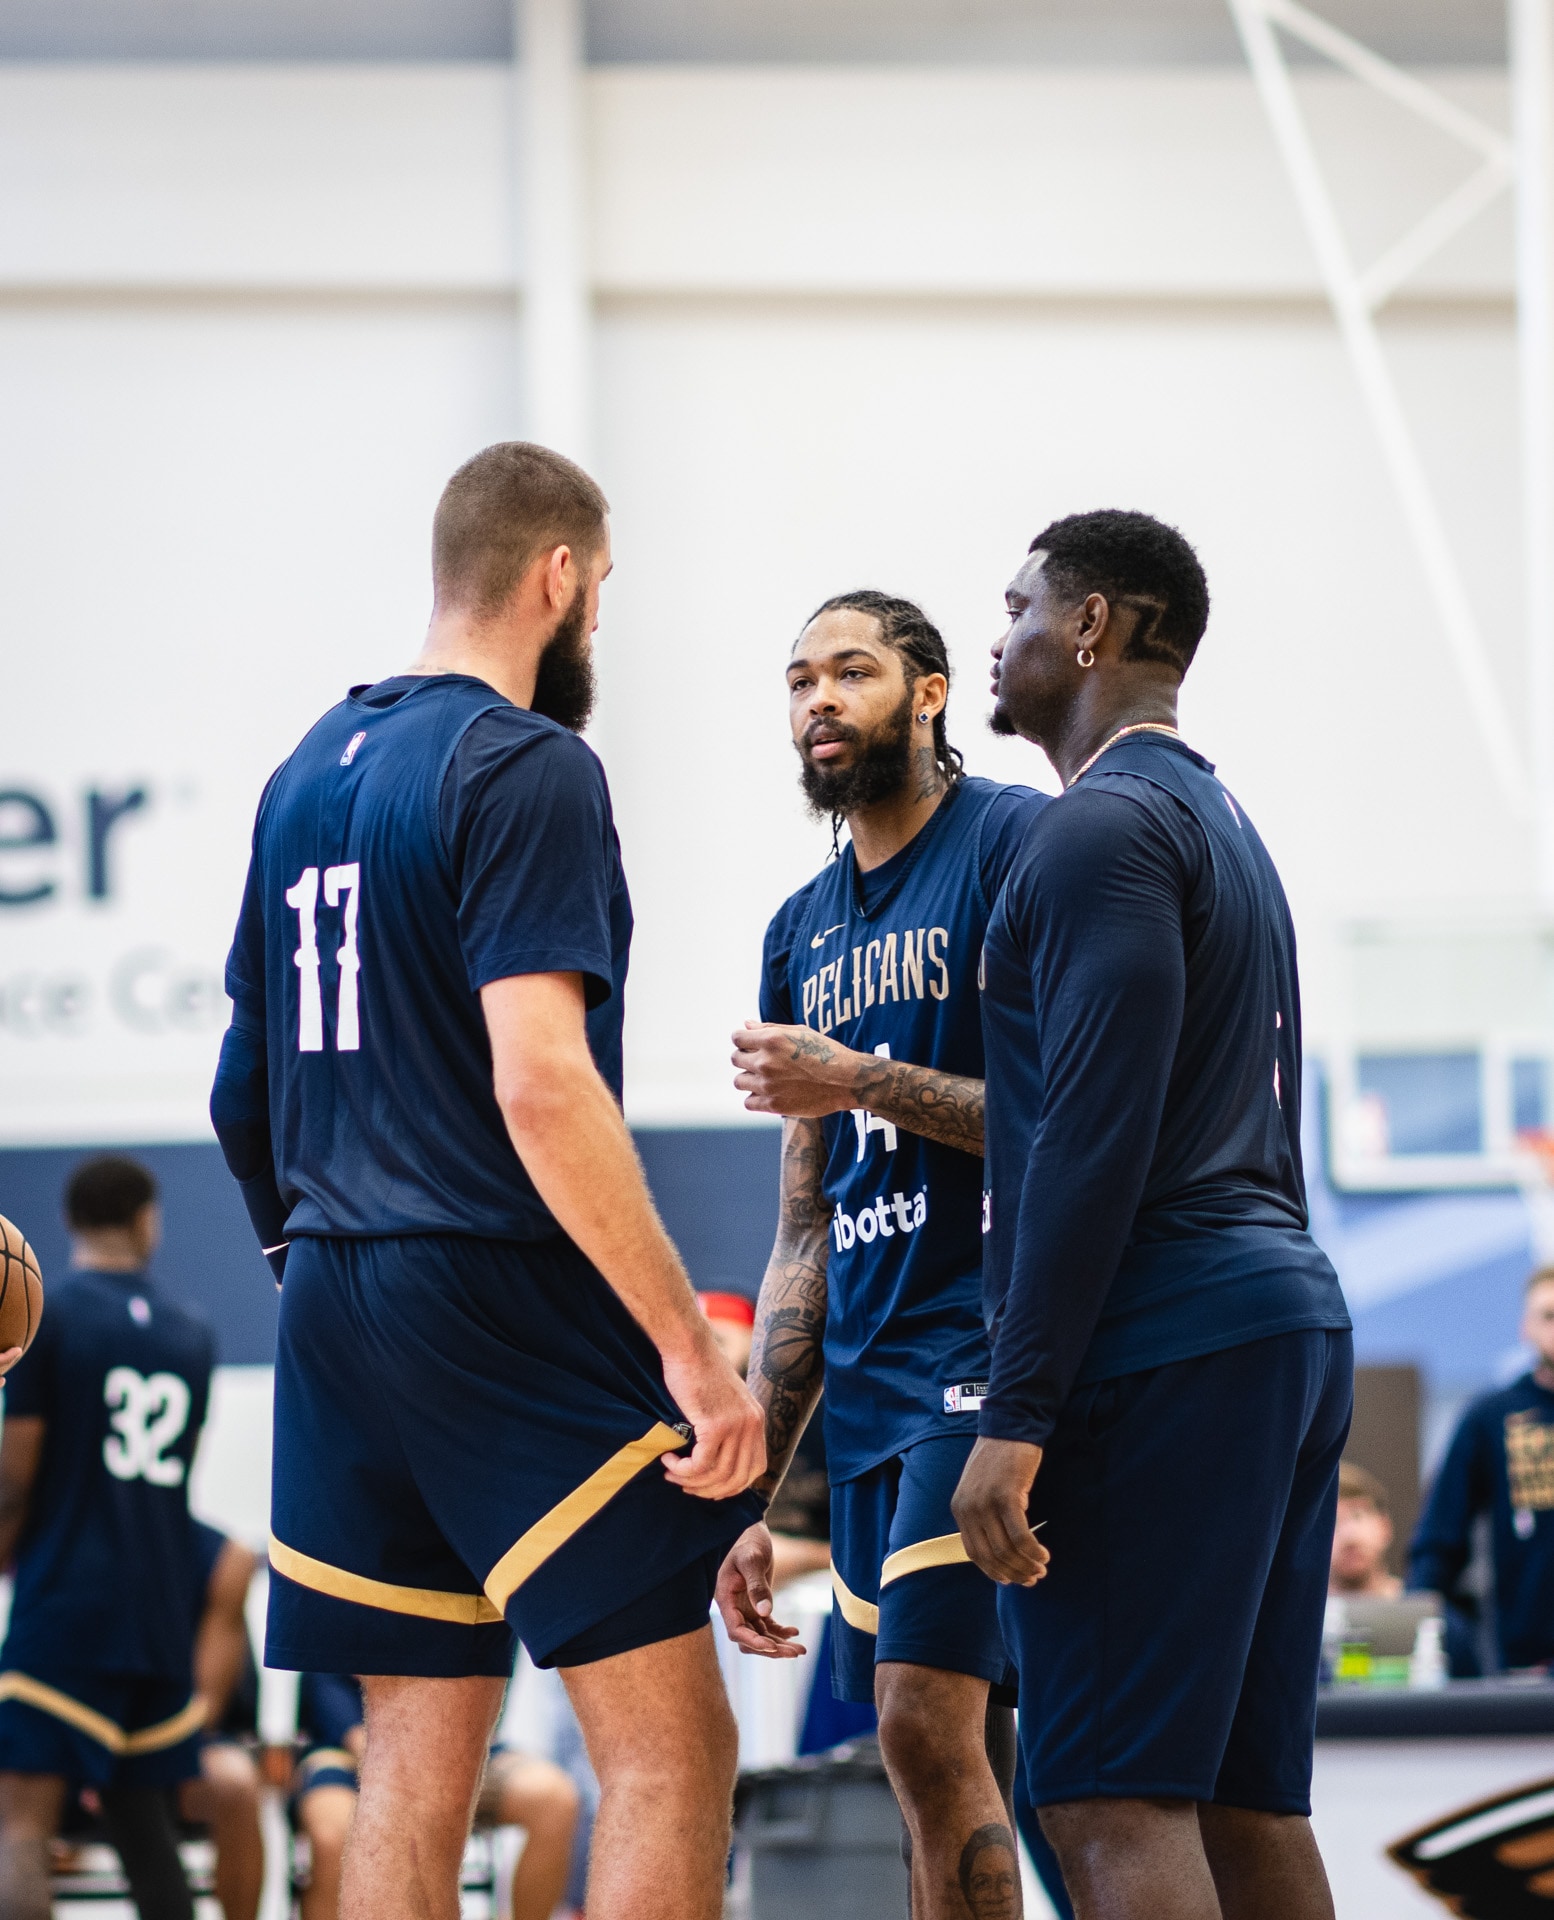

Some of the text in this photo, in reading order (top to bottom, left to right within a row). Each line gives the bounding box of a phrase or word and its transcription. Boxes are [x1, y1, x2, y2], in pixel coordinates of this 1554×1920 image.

[286, 862, 360, 1052] 17
[802, 927, 950, 1035] PELICANS
[834, 1192, 927, 1252] ibotta
[104, 1366, 191, 1488] 32
